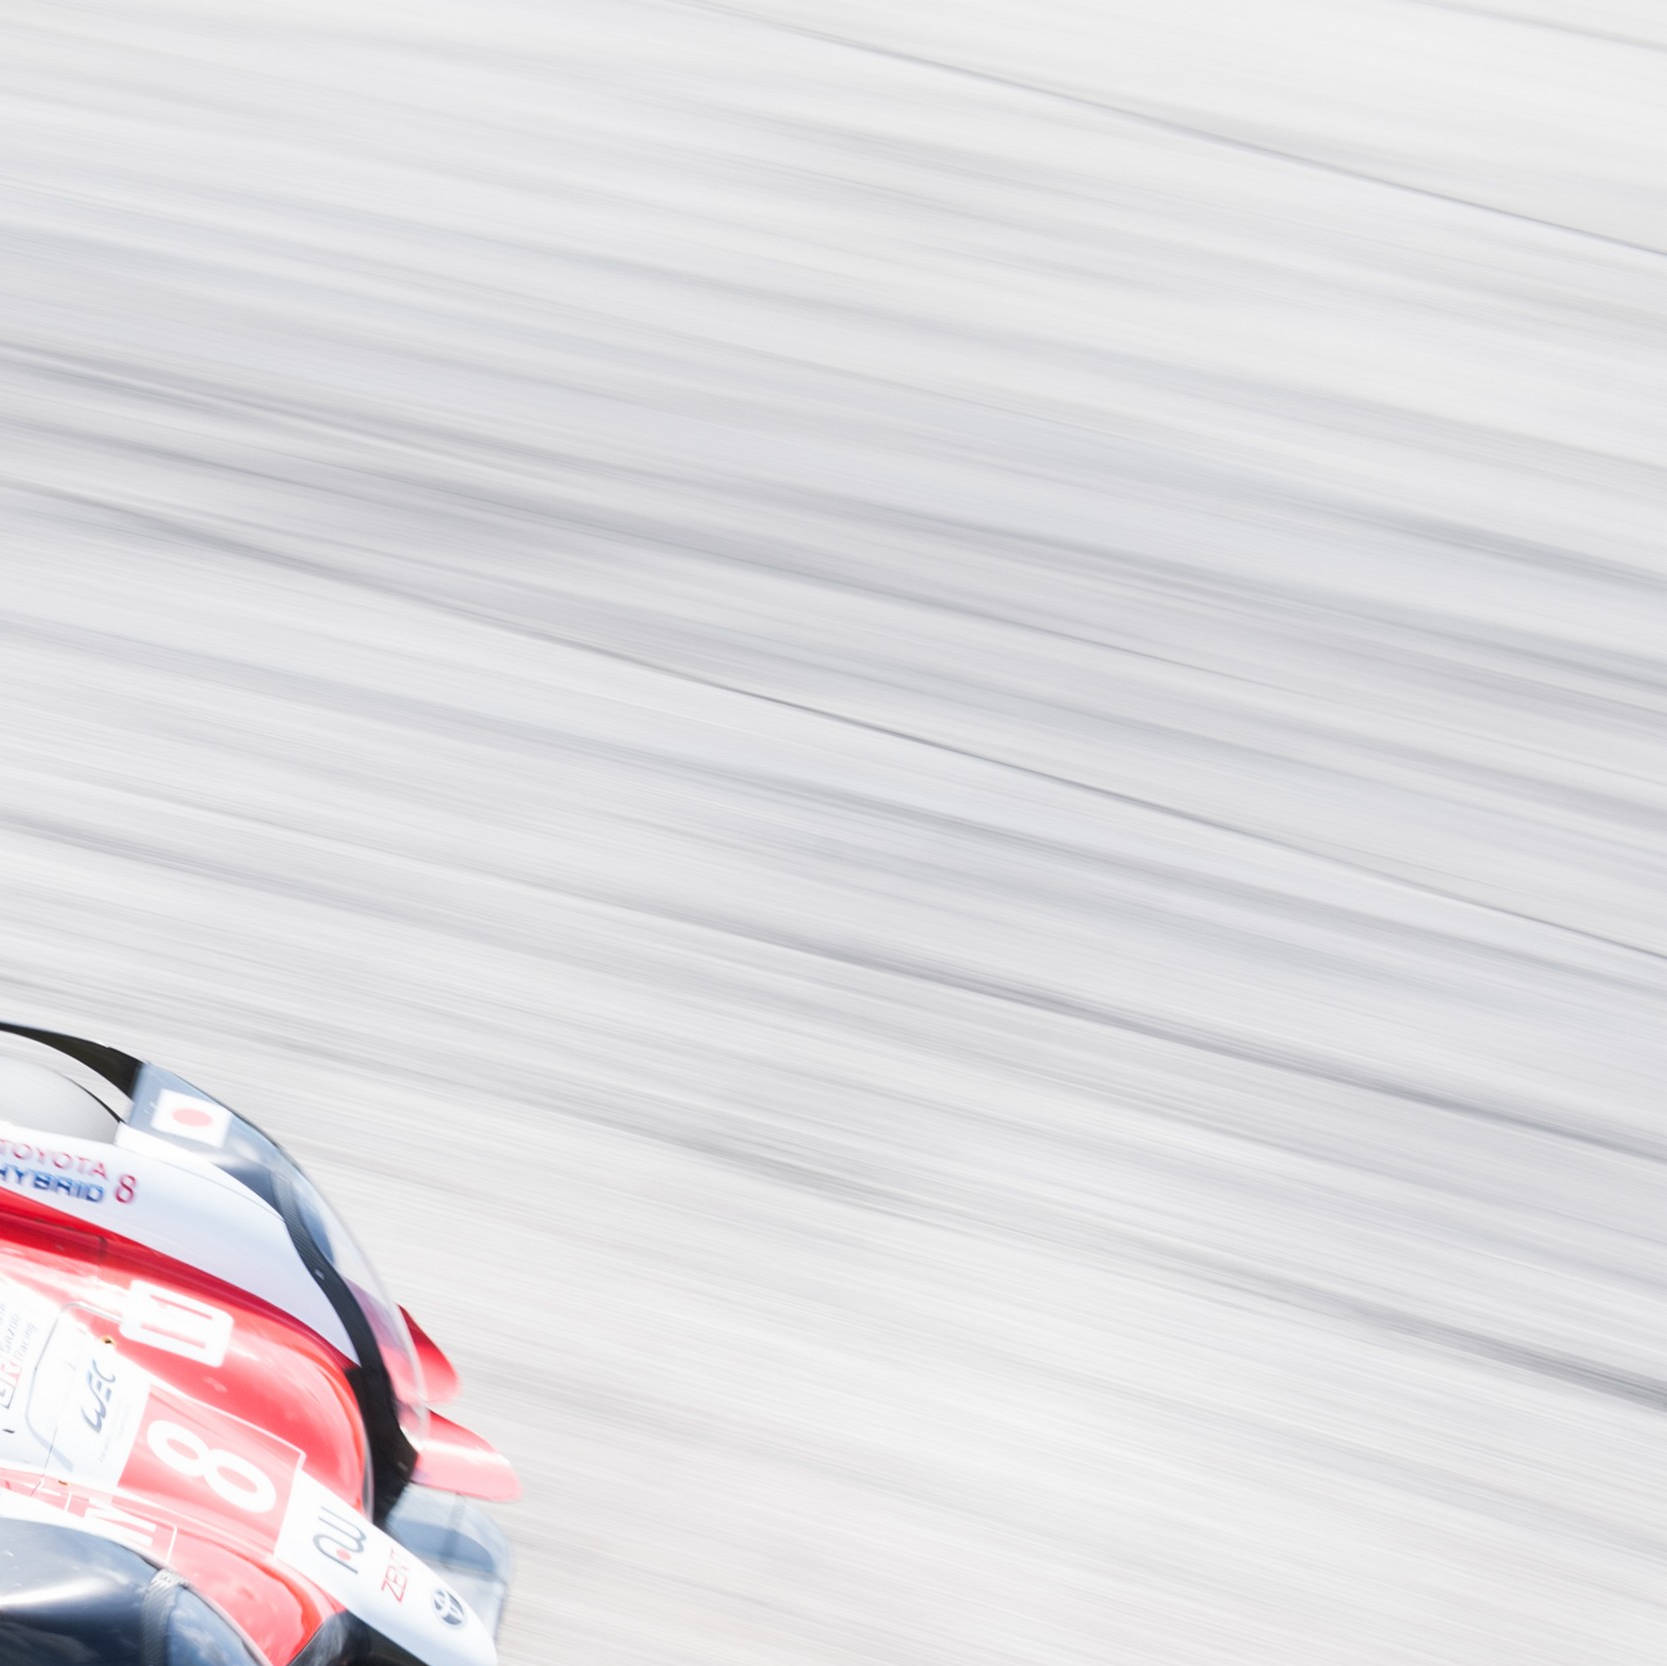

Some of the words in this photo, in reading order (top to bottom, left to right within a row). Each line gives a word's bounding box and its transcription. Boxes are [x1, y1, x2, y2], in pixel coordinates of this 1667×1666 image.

[114, 1172, 138, 1205] 8
[80, 1358, 117, 1434] WEC
[146, 1419, 277, 1514] 8
